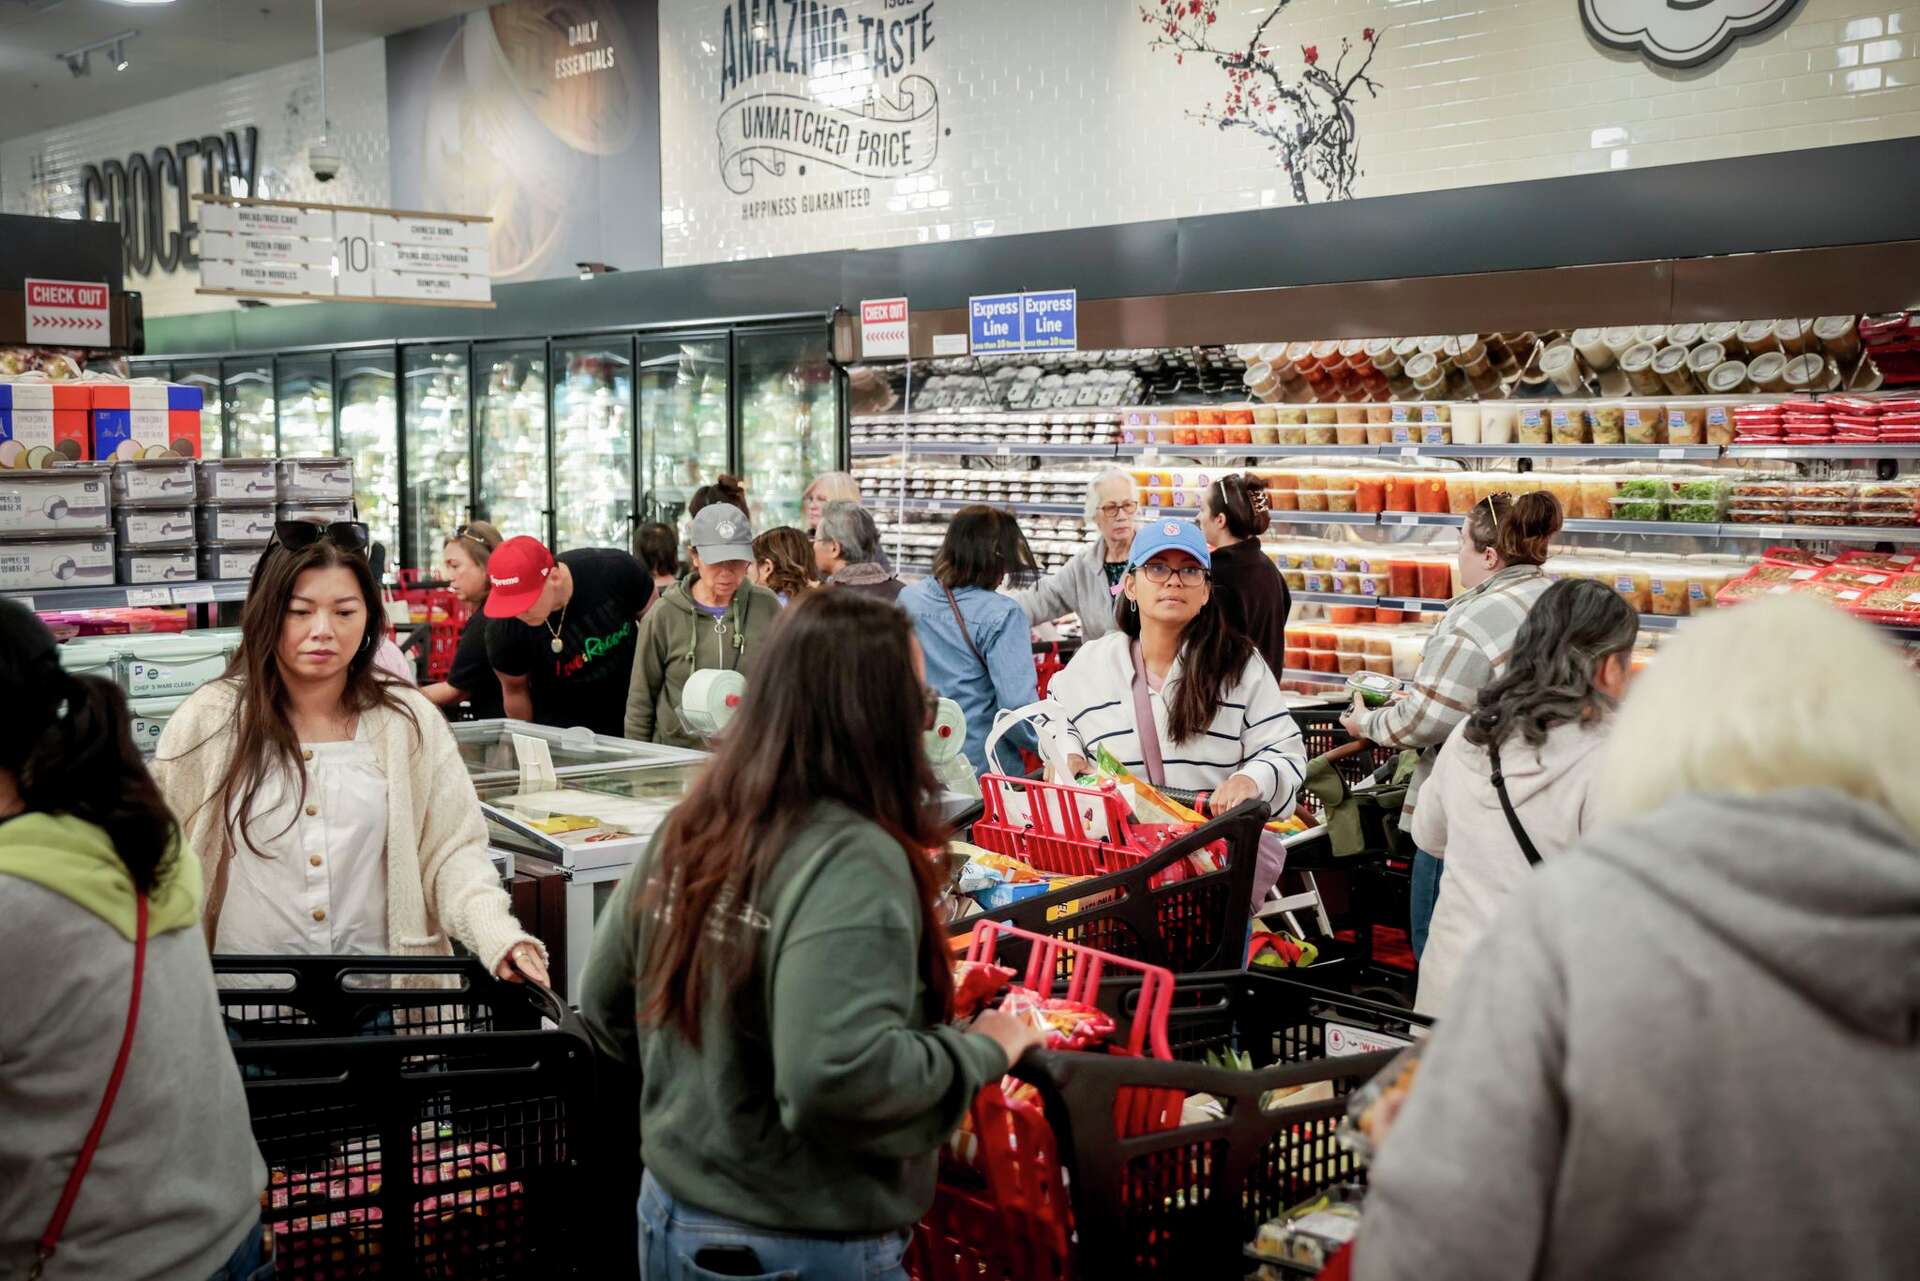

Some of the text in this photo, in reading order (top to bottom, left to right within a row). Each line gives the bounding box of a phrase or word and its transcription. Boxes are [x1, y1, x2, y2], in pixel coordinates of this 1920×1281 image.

[568, 20, 599, 47] DAILY
[555, 46, 615, 79] ESSENTIALS
[720, 0, 936, 104] AMAZING TASTE
[742, 105, 913, 168] UNMATCHED PRICE
[742, 187, 871, 221] HAPPINESS GUARANTEED
[339, 236, 369, 273] 10
[33, 286, 103, 306] CHECK OUT
[1025, 298, 1073, 316] Express
[865, 303, 905, 321] CHECK OUT
[973, 302, 1018, 319] Express
[983, 320, 1009, 336] Line
[1035, 316, 1062, 333] Line
